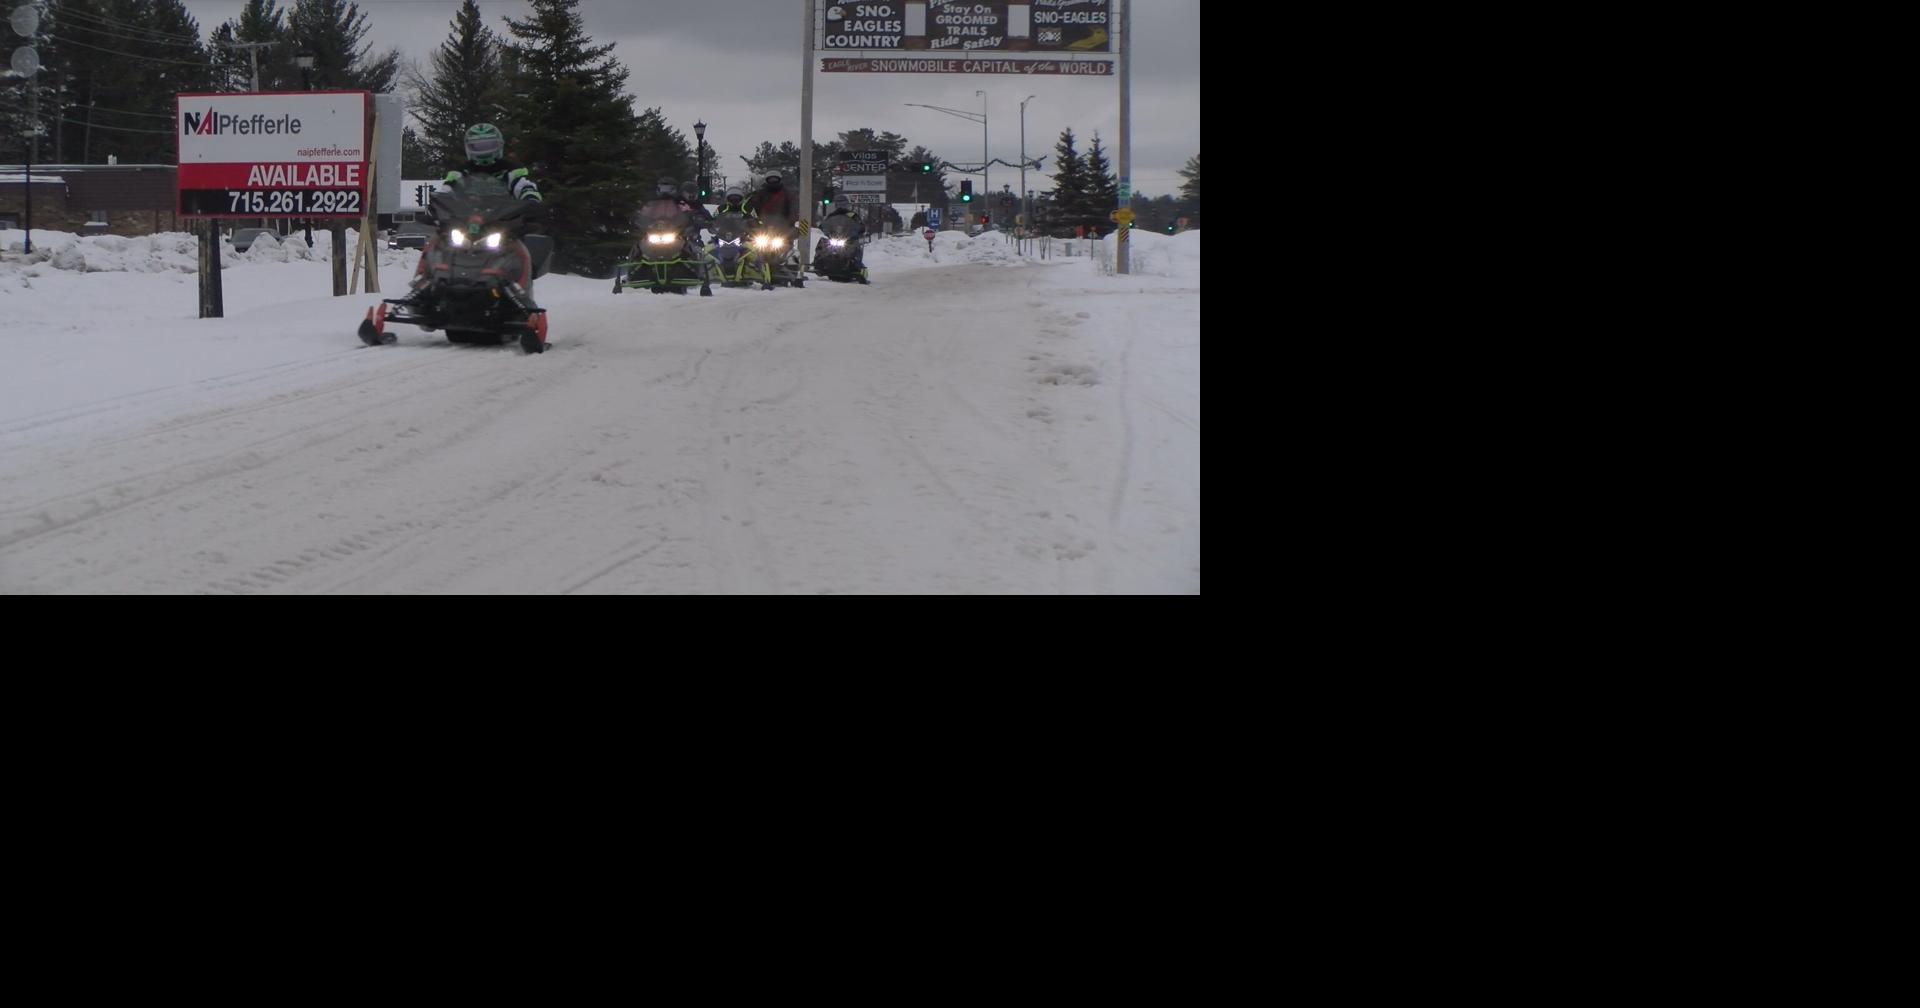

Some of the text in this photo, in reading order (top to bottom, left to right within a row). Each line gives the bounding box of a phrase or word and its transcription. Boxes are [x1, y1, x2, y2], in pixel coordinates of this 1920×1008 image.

[856, 5, 896, 17] SNO-
[943, 4, 971, 15] Stay
[974, 4, 992, 14] On
[936, 15, 998, 25] GROOMED
[1034, 11, 1107, 24] SNO-EAGLES
[844, 20, 901, 32] EAGLES
[946, 26, 988, 36] TRAILS
[826, 35, 901, 47] COUNTRY
[931, 35, 1004, 50] Ride Safely
[871, 60, 1106, 74] SNOWMOBILE CAPITAL of the WORLD
[297, 147, 360, 158] naipfefferle.com
[851, 152, 878, 160] Vilas
[247, 164, 360, 187] AVAILABLE
[229, 191, 360, 213] 715.261.2922
[930, 209, 939, 218] H
